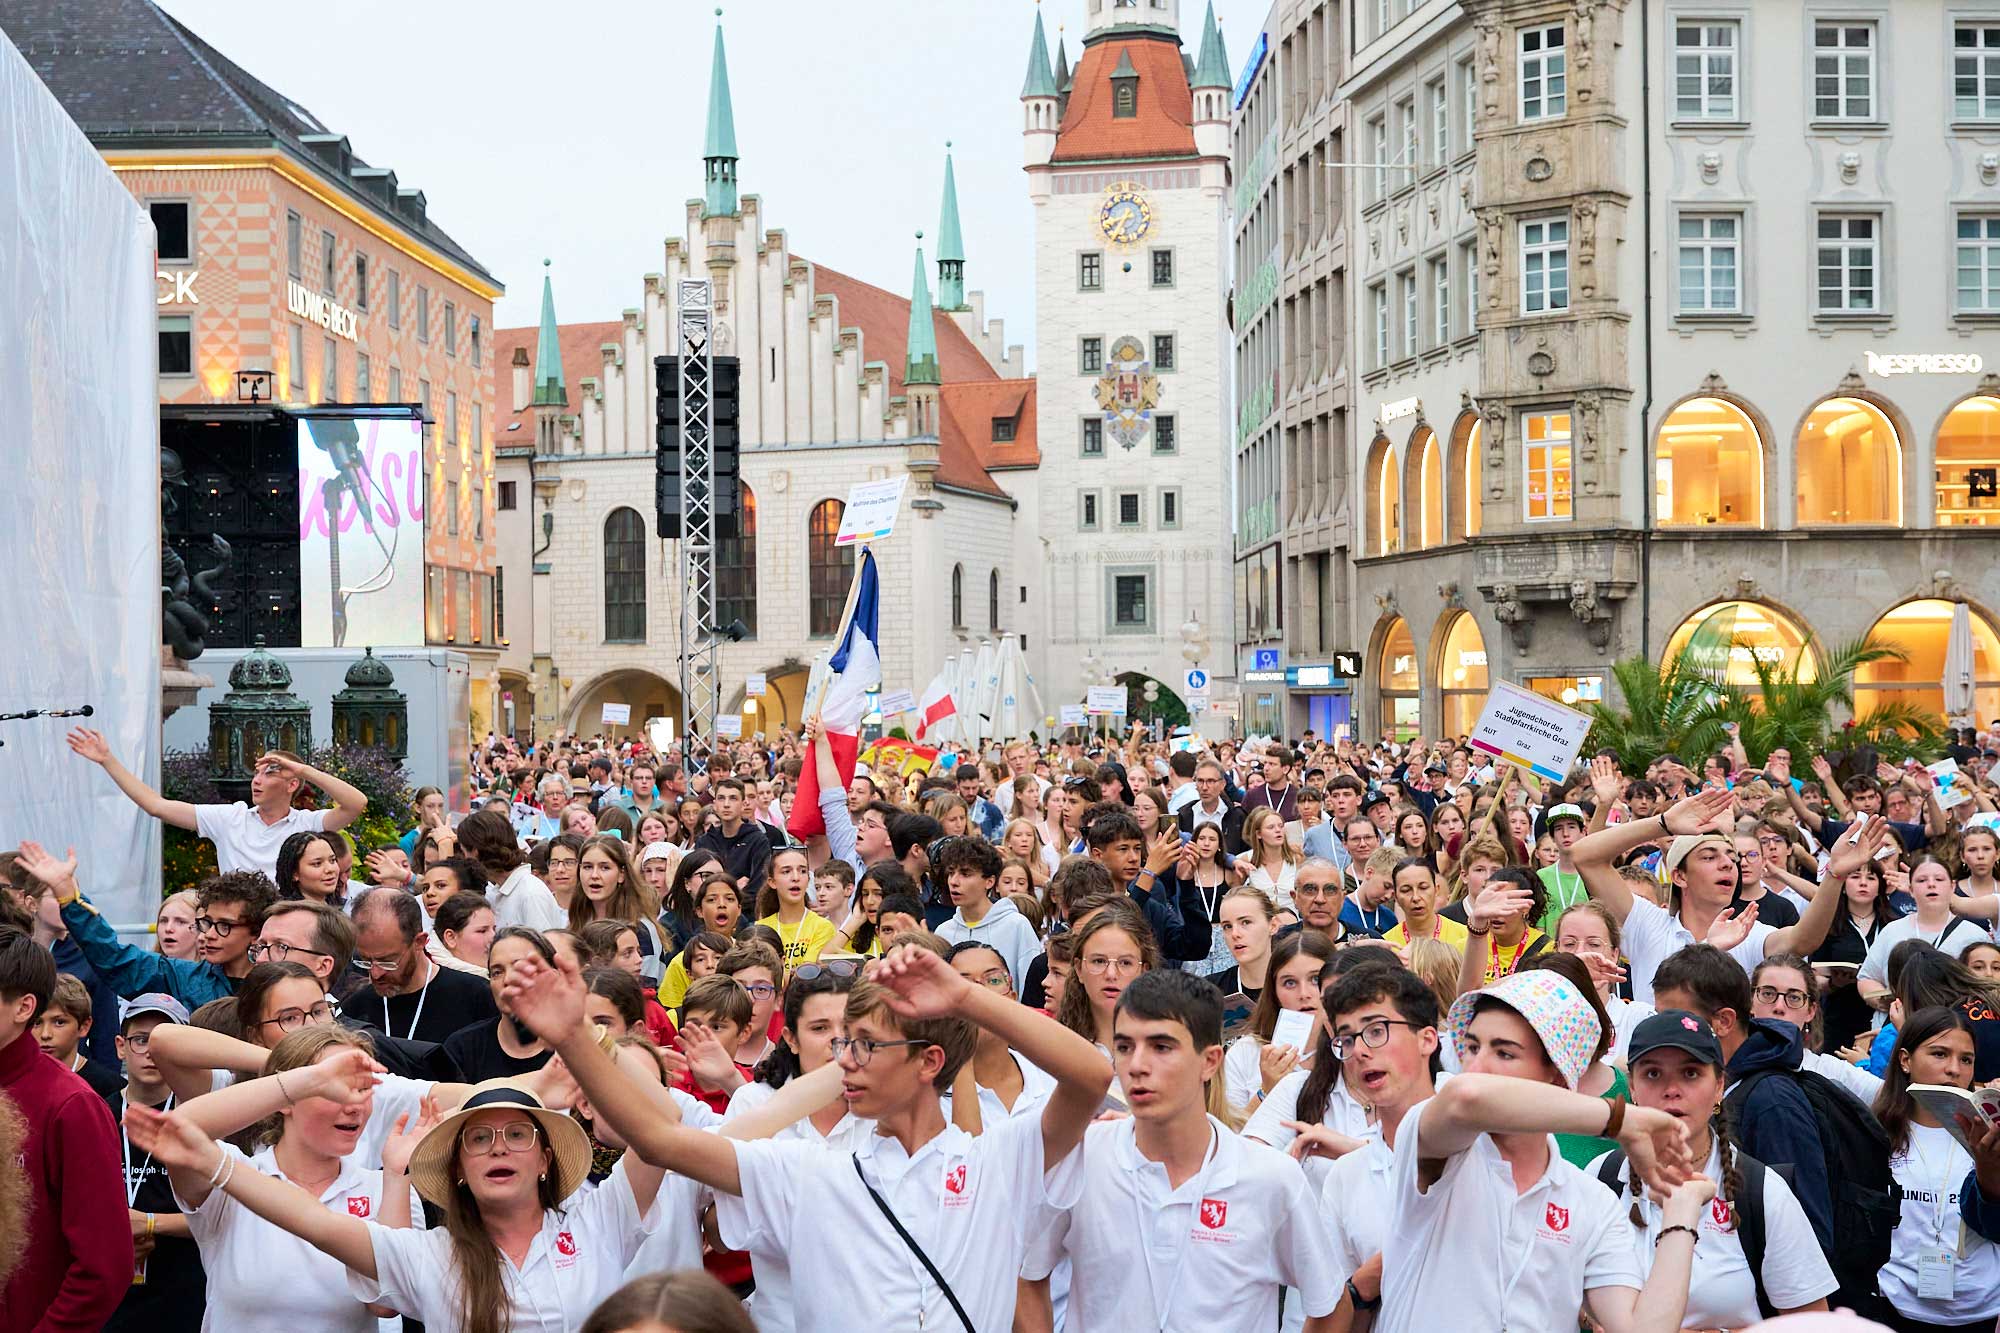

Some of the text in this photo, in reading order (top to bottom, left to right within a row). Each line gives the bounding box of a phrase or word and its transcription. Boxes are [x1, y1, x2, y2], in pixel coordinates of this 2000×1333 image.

[288, 280, 359, 343] LUDWIG BECK
[1864, 350, 1983, 378] NESPRESSO
[1336, 655, 1358, 675] N
[1494, 710, 1569, 746] Stadtpfarrkirche Graz
[1508, 706, 1552, 729] Jugendchor
[1550, 722, 1563, 733] der
[1483, 726, 1497, 736] AUT
[1516, 740, 1532, 750] Graz
[1551, 755, 1564, 764] 132
[1902, 1190, 1938, 1204] UNICH
